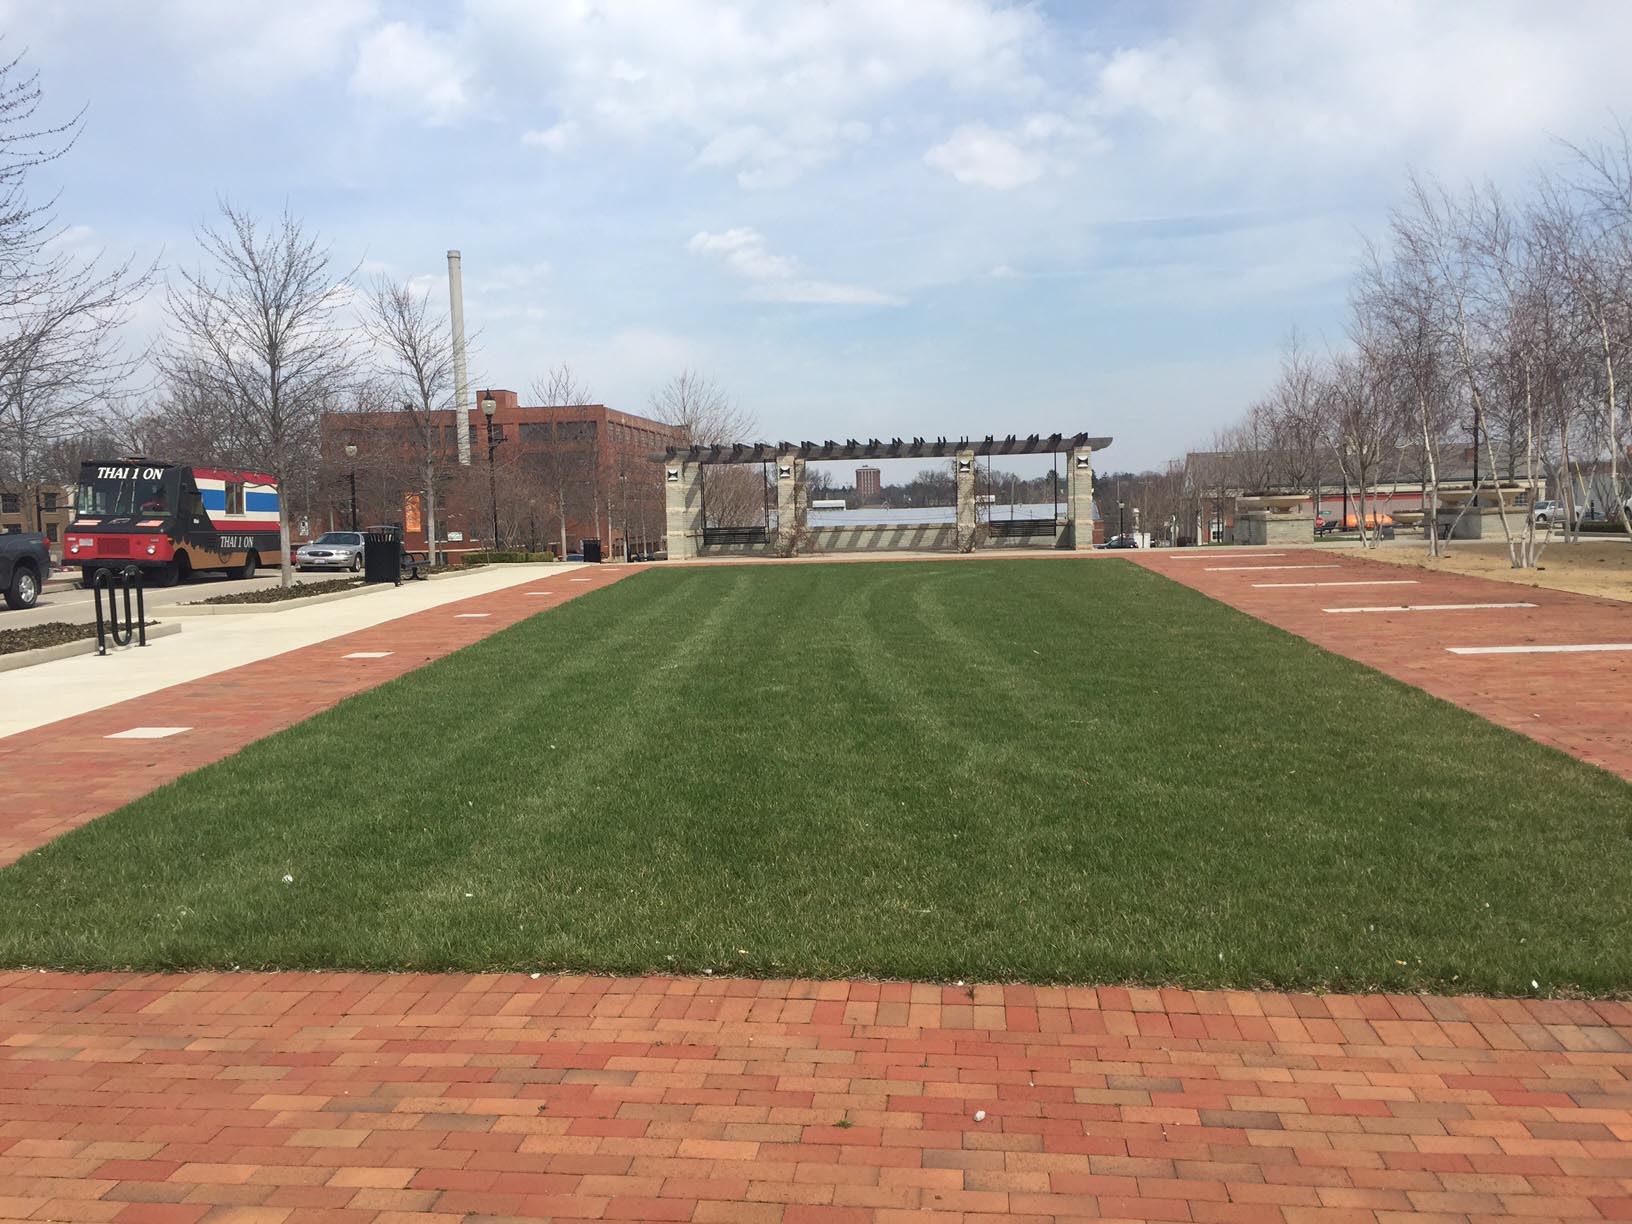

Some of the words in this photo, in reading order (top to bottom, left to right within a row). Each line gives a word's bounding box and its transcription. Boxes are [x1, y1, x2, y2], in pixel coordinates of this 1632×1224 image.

[97, 467, 130, 479] THAI
[131, 467, 140, 480] 1
[142, 467, 164, 480] ON
[220, 535, 237, 548] THAI
[243, 535, 254, 548] ON
